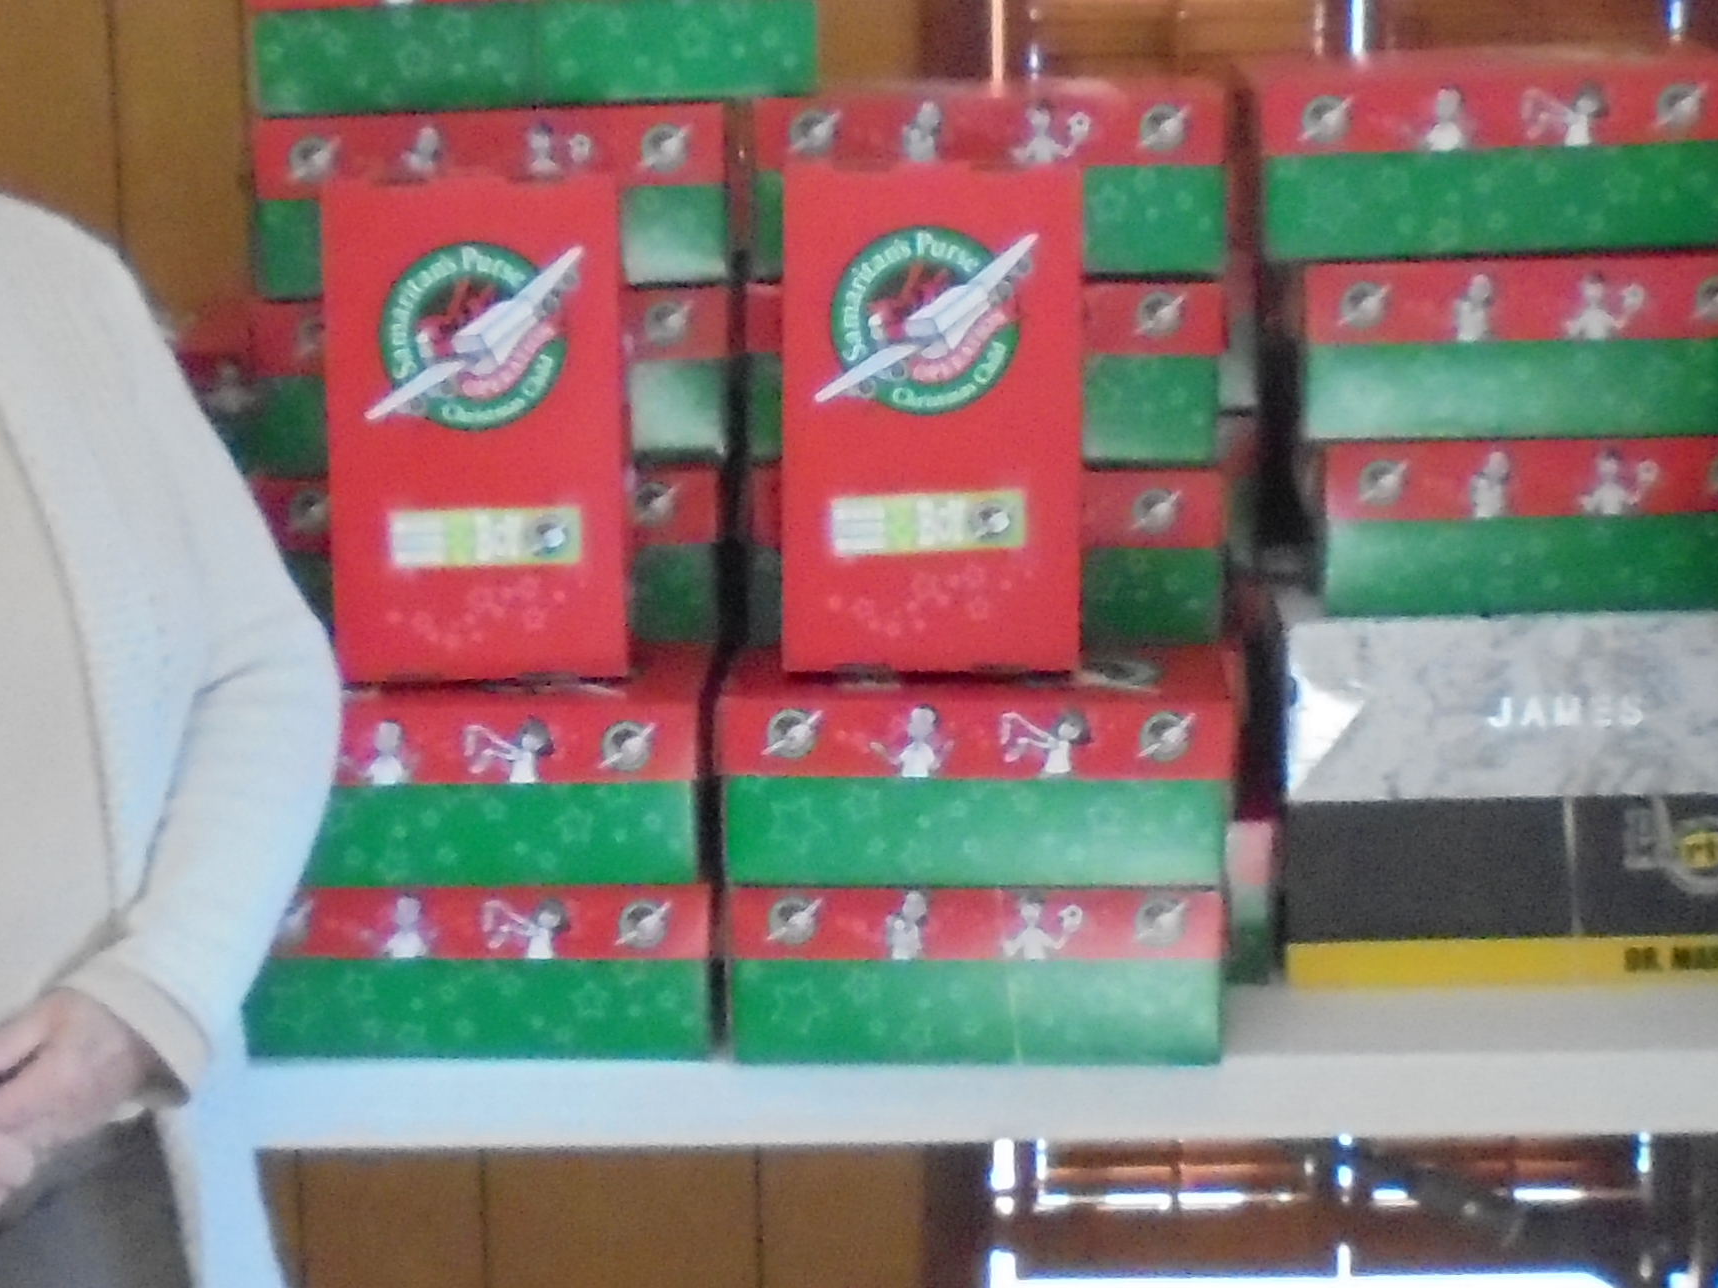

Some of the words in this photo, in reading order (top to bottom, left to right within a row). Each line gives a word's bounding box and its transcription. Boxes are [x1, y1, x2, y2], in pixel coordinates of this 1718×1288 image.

[391, 254, 459, 380] Samaritan's
[461, 245, 527, 288] Purse
[841, 237, 913, 362] Samaritan's
[916, 230, 981, 273] Purse
[1486, 695, 1645, 728] JAMES
